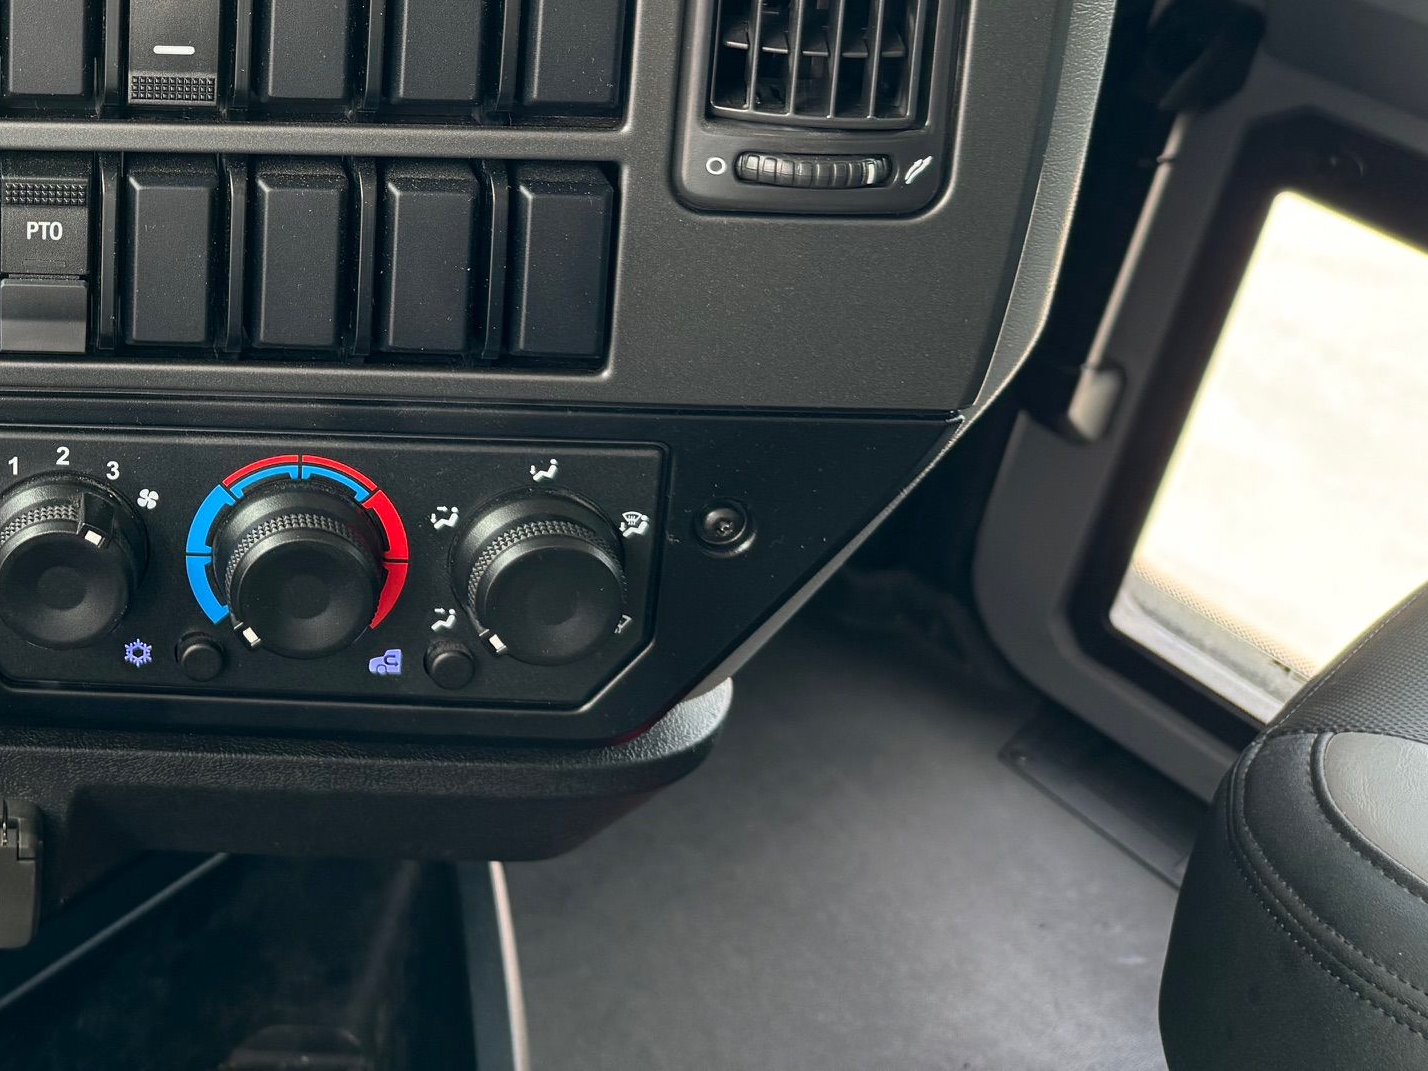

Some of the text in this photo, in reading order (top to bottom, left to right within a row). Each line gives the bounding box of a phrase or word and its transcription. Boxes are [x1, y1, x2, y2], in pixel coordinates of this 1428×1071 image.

[26, 221, 63, 240] PTO
[56, 446, 70, 466] 2
[8, 457, 19, 476] 1
[106, 461, 119, 480] 3
